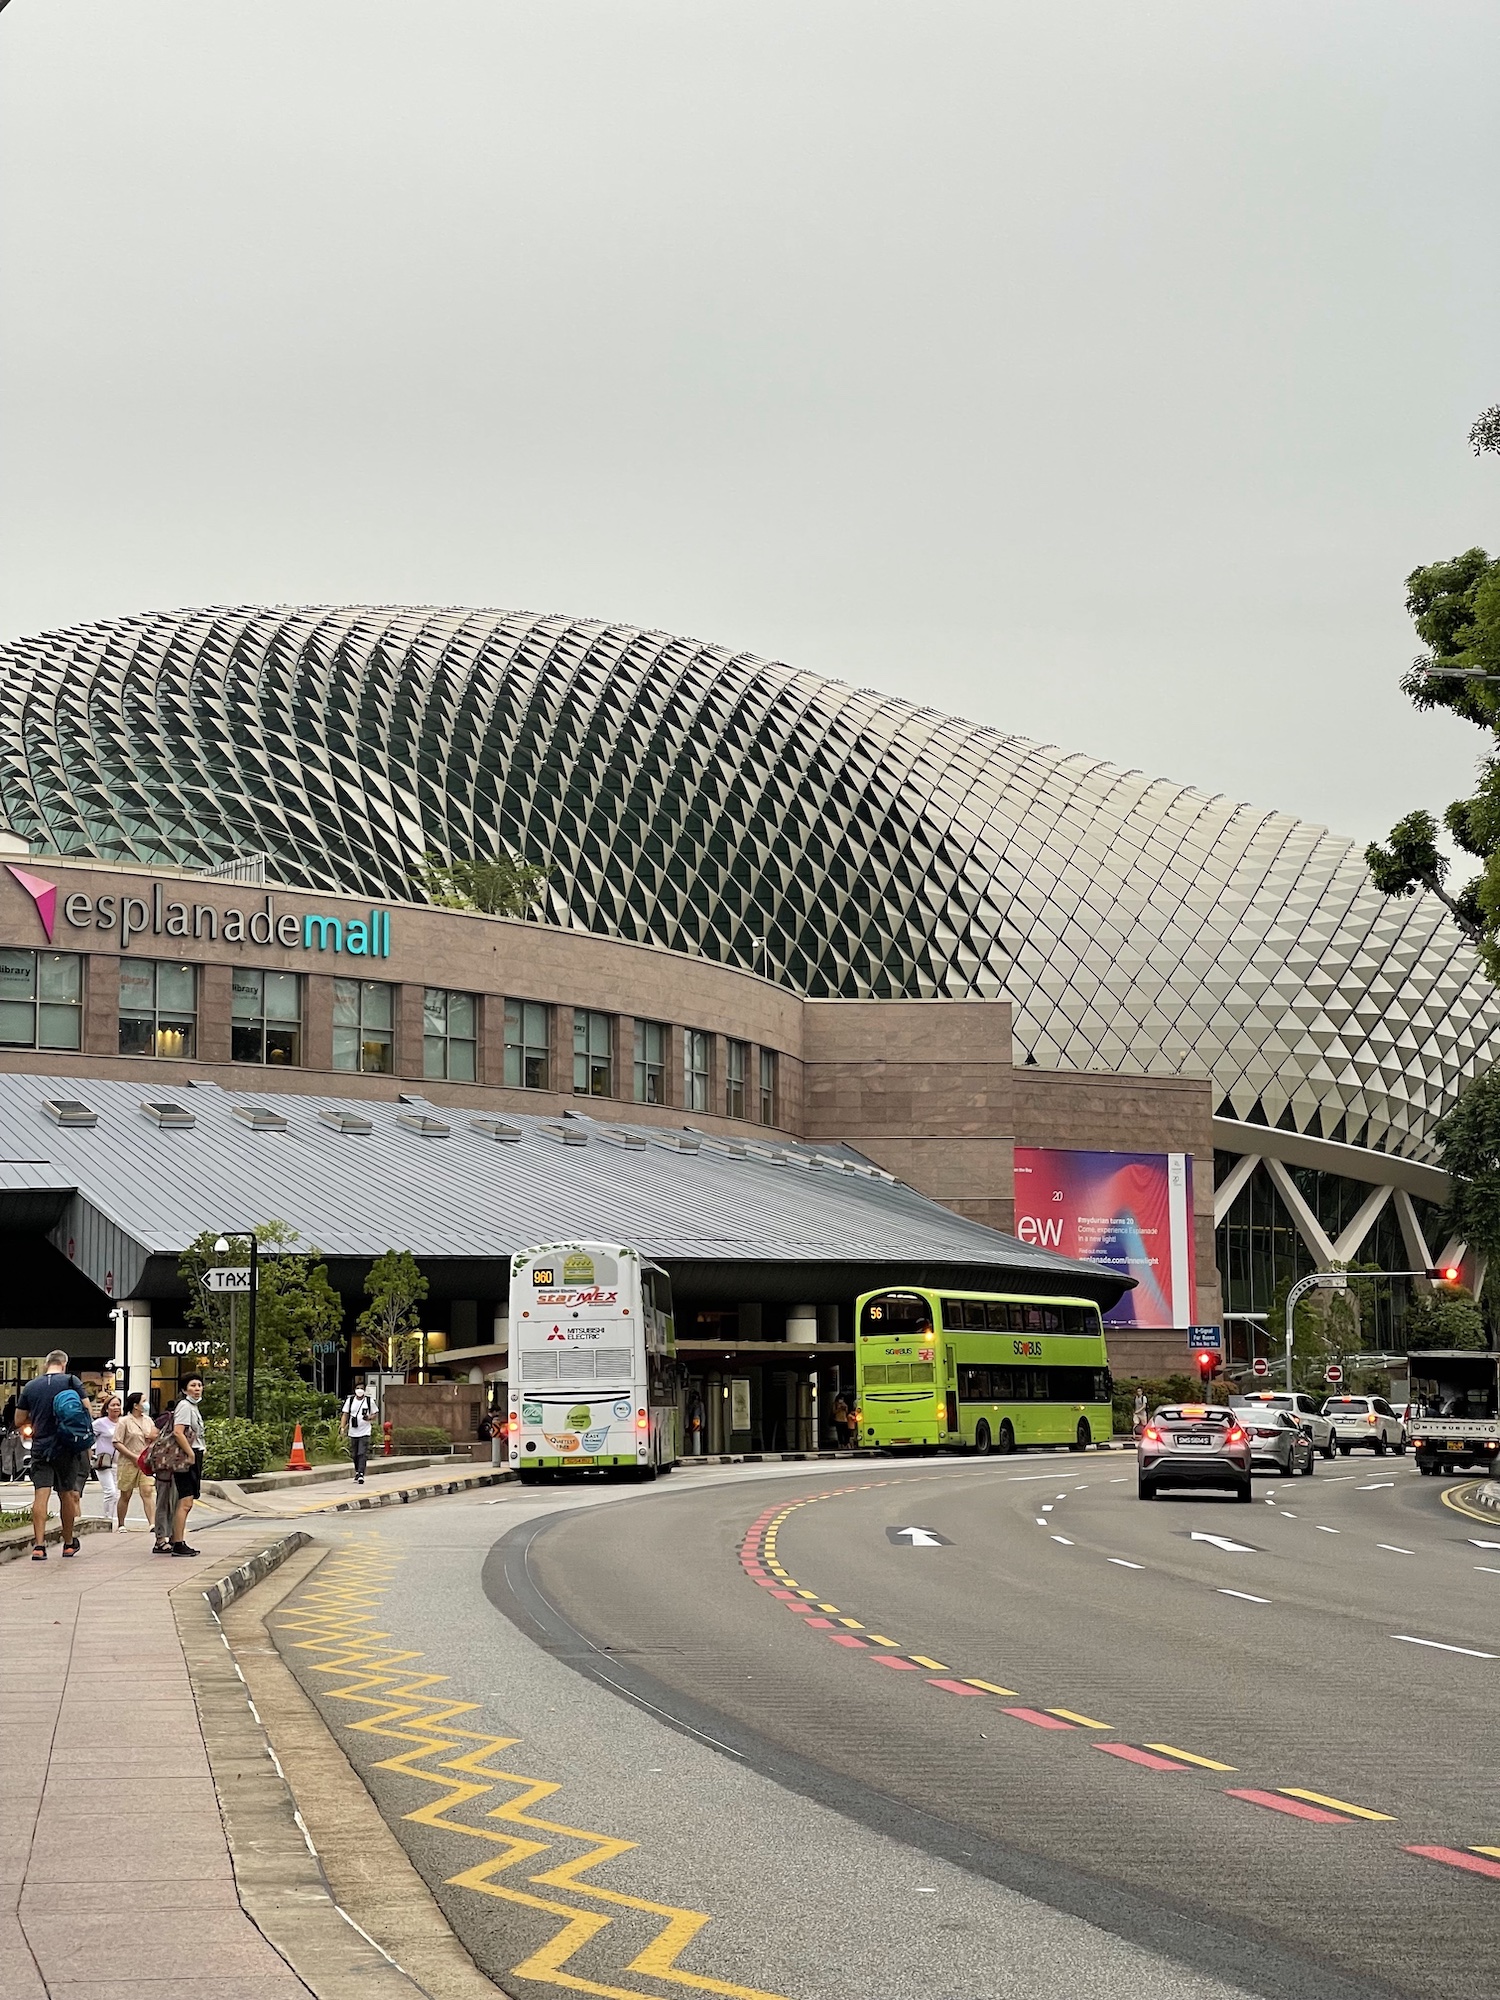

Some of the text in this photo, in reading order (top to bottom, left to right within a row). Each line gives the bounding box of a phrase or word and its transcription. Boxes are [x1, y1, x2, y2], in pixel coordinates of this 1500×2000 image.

[1052, 1190, 1063, 1201] 20
[1018, 1216, 1063, 1247] ew
[1097, 1226, 1128, 1234] experience
[1128, 1226, 1158, 1235] Esplanade
[534, 1270, 553, 1284] 960
[870, 1306, 883, 1320] 56
[168, 1341, 211, 1355] TOAST
